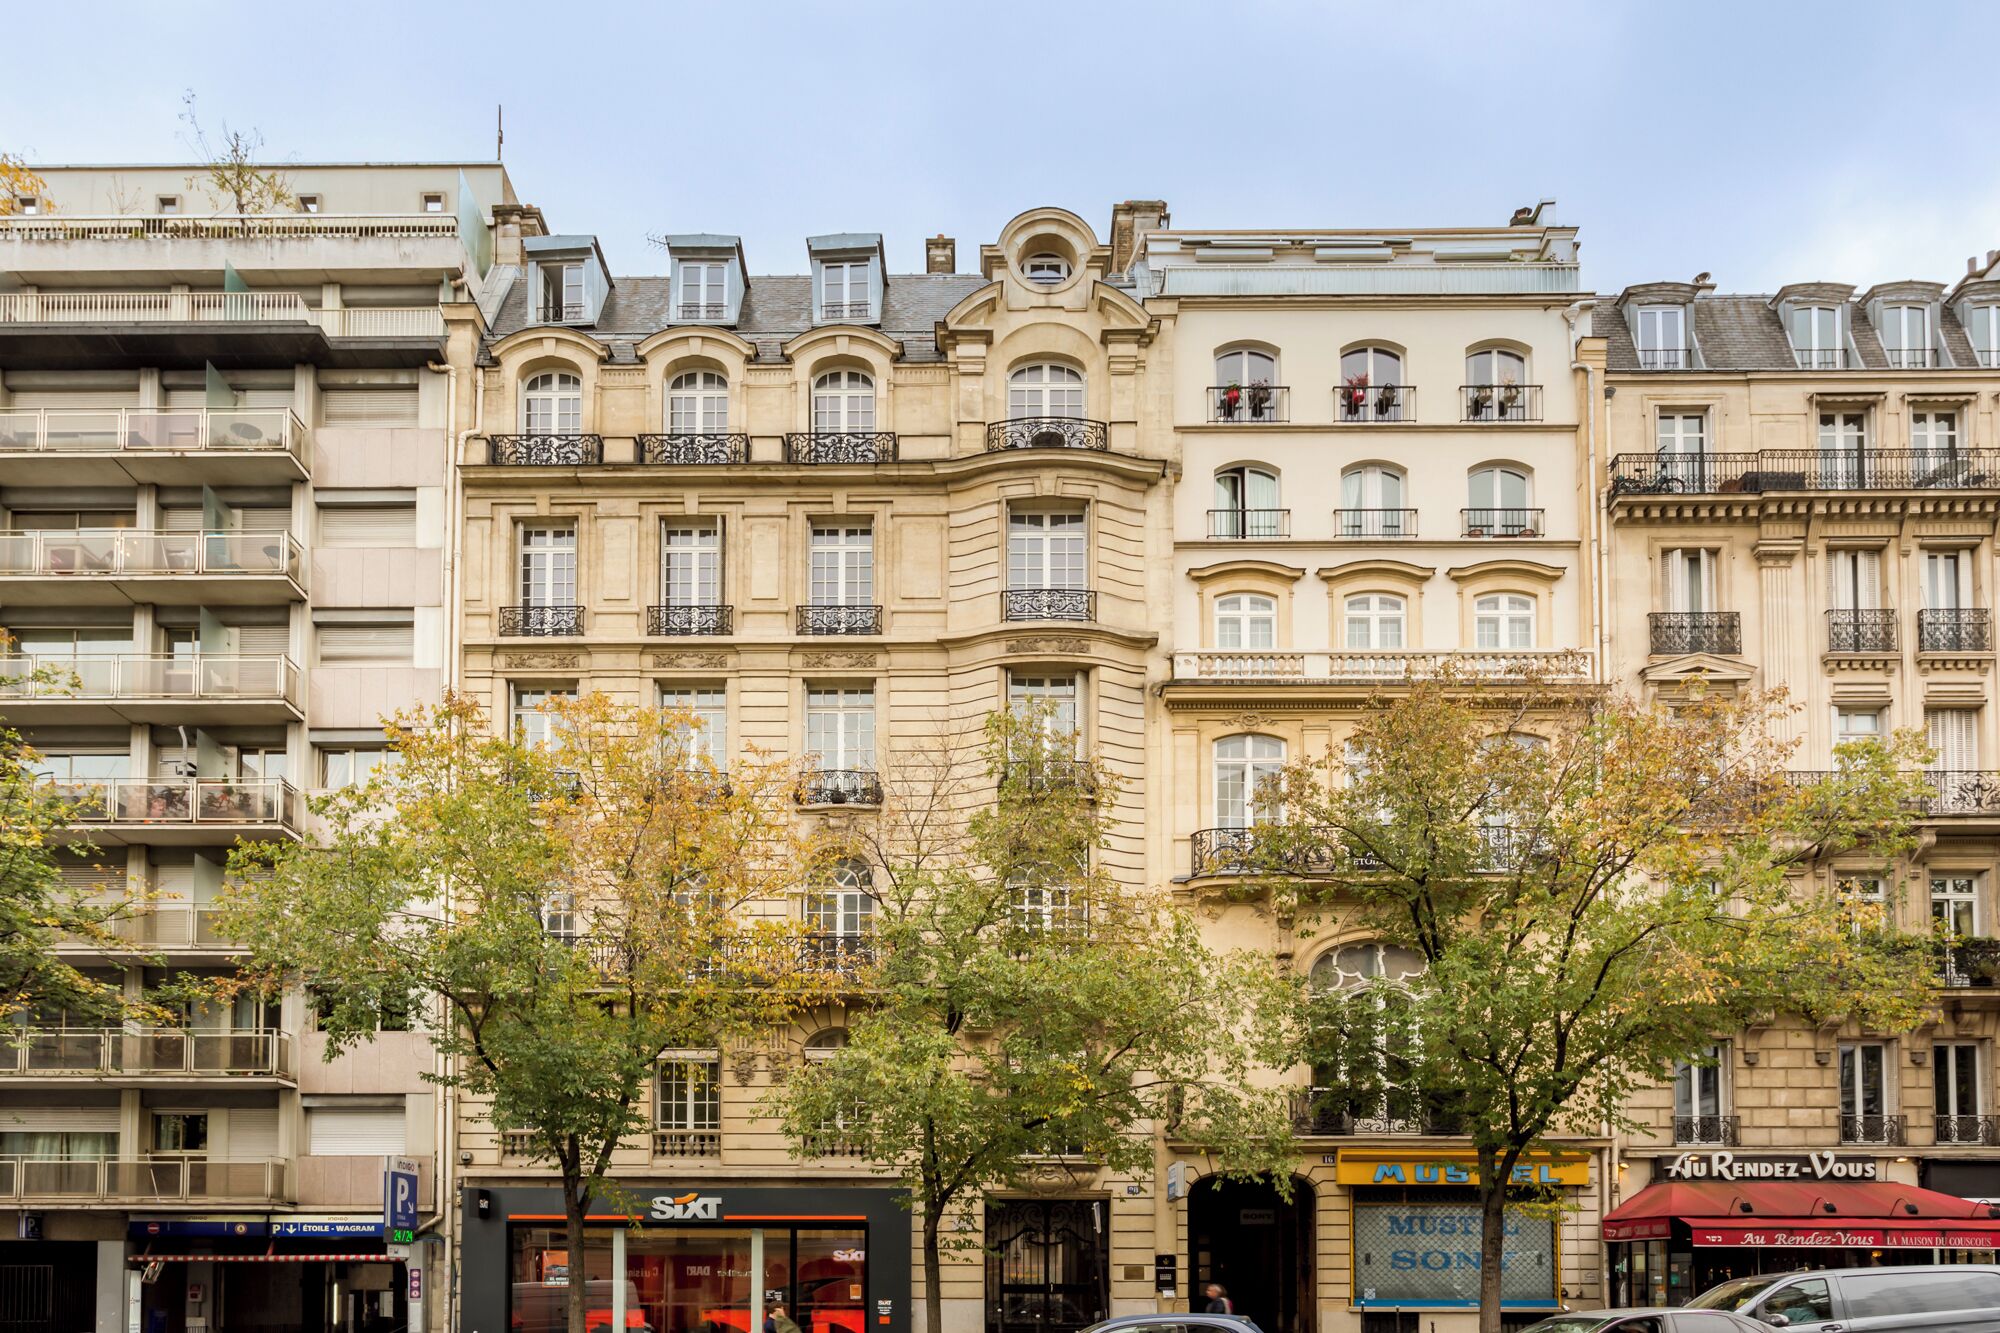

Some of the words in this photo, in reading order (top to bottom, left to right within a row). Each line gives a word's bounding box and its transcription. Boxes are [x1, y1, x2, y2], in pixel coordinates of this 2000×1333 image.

[1324, 1155, 1334, 1163] 16
[1373, 1164, 1560, 1183] MUSEL
[397, 1177, 409, 1213] P
[272, 1224, 281, 1234] P
[302, 1224, 330, 1232] ÉTOILE
[1740, 1232, 1766, 1245] Au
[1774, 1232, 1874, 1245] Rendez-Vous
[1887, 1236, 1897, 1245] LA
[1901, 1236, 1933, 1246] MAISON
[1935, 1236, 1947, 1246] DU
[1949, 1237, 1992, 1246] COUSCOUS
